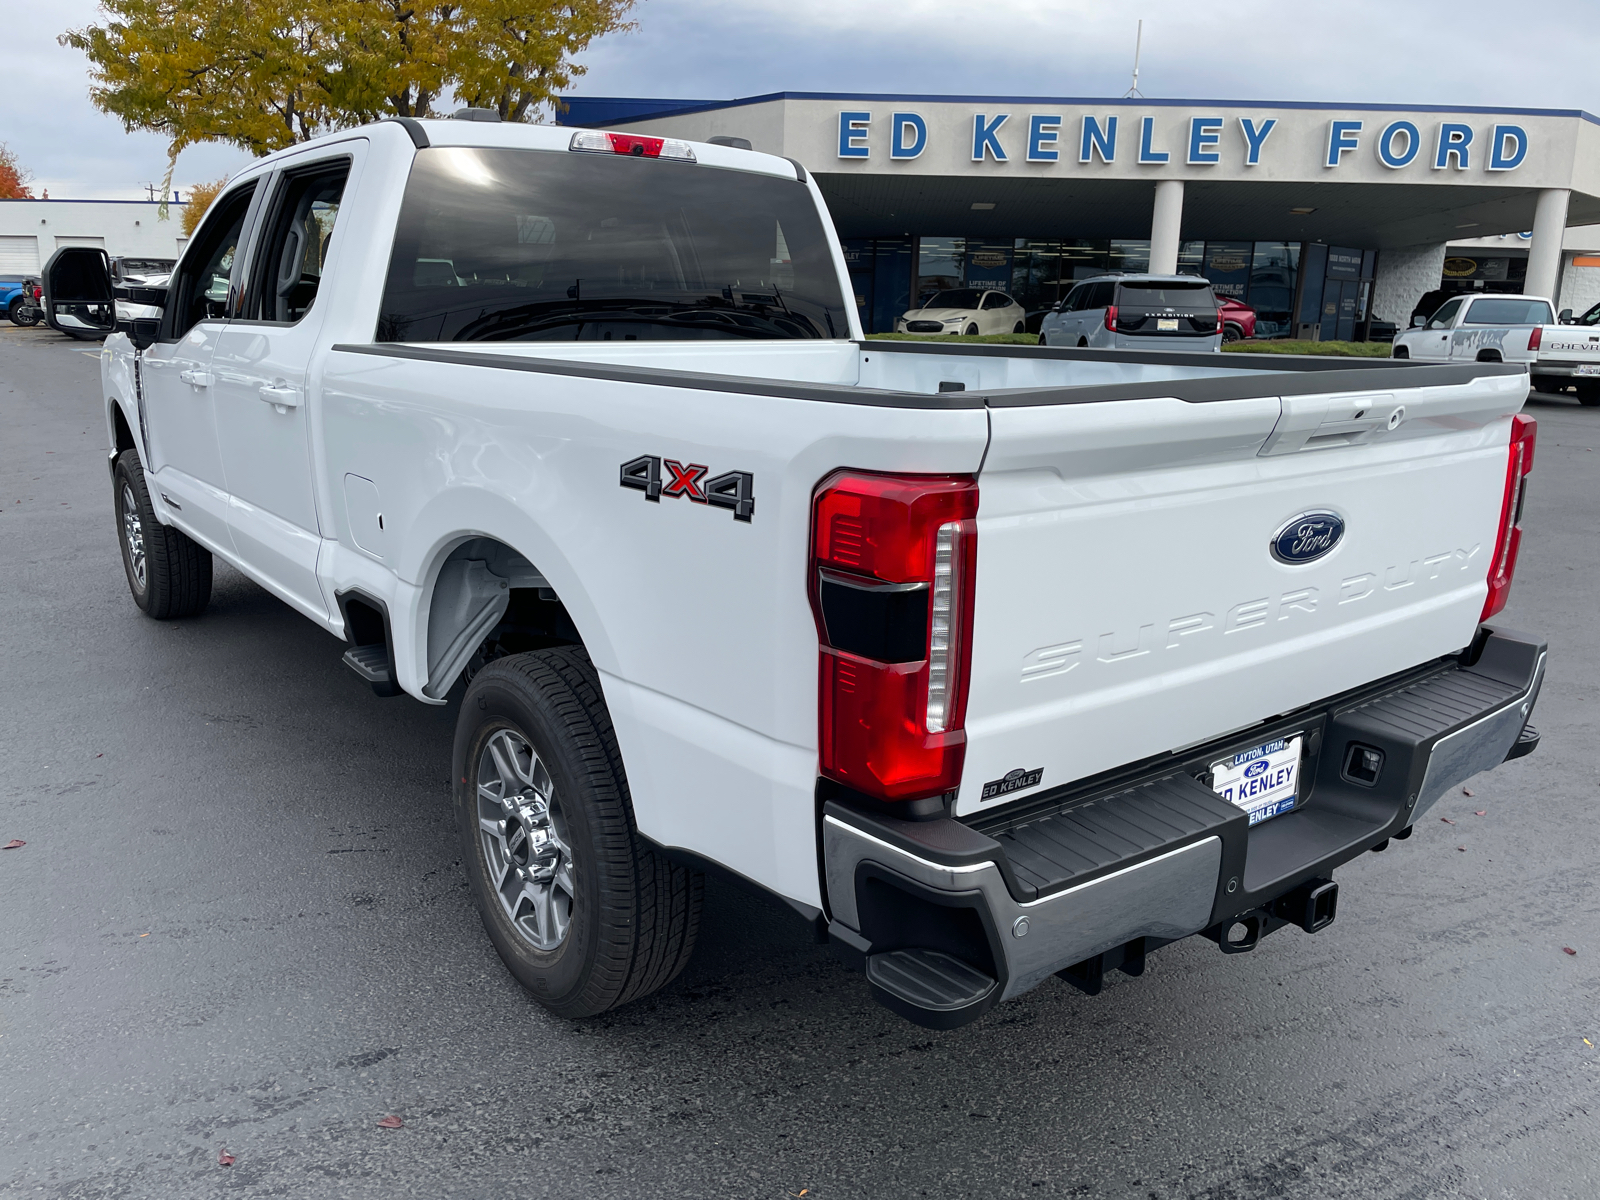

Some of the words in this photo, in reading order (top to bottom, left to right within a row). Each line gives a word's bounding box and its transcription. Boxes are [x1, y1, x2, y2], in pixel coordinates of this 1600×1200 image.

[838, 111, 928, 160] ED
[971, 113, 1279, 166] KENLEY
[1323, 119, 1529, 171] FORD
[1292, 521, 1333, 555] Ford
[1020, 586, 1319, 683] SUPER
[1338, 543, 1480, 605] DUTY
[1234, 746, 1264, 766] LAYTON,
[1265, 739, 1284, 754] UTAH
[982, 784, 998, 798] ED
[1000, 772, 1042, 793] KENLEY
[1239, 765, 1294, 801] KENLEY
[1249, 803, 1279, 825] ENLEY
